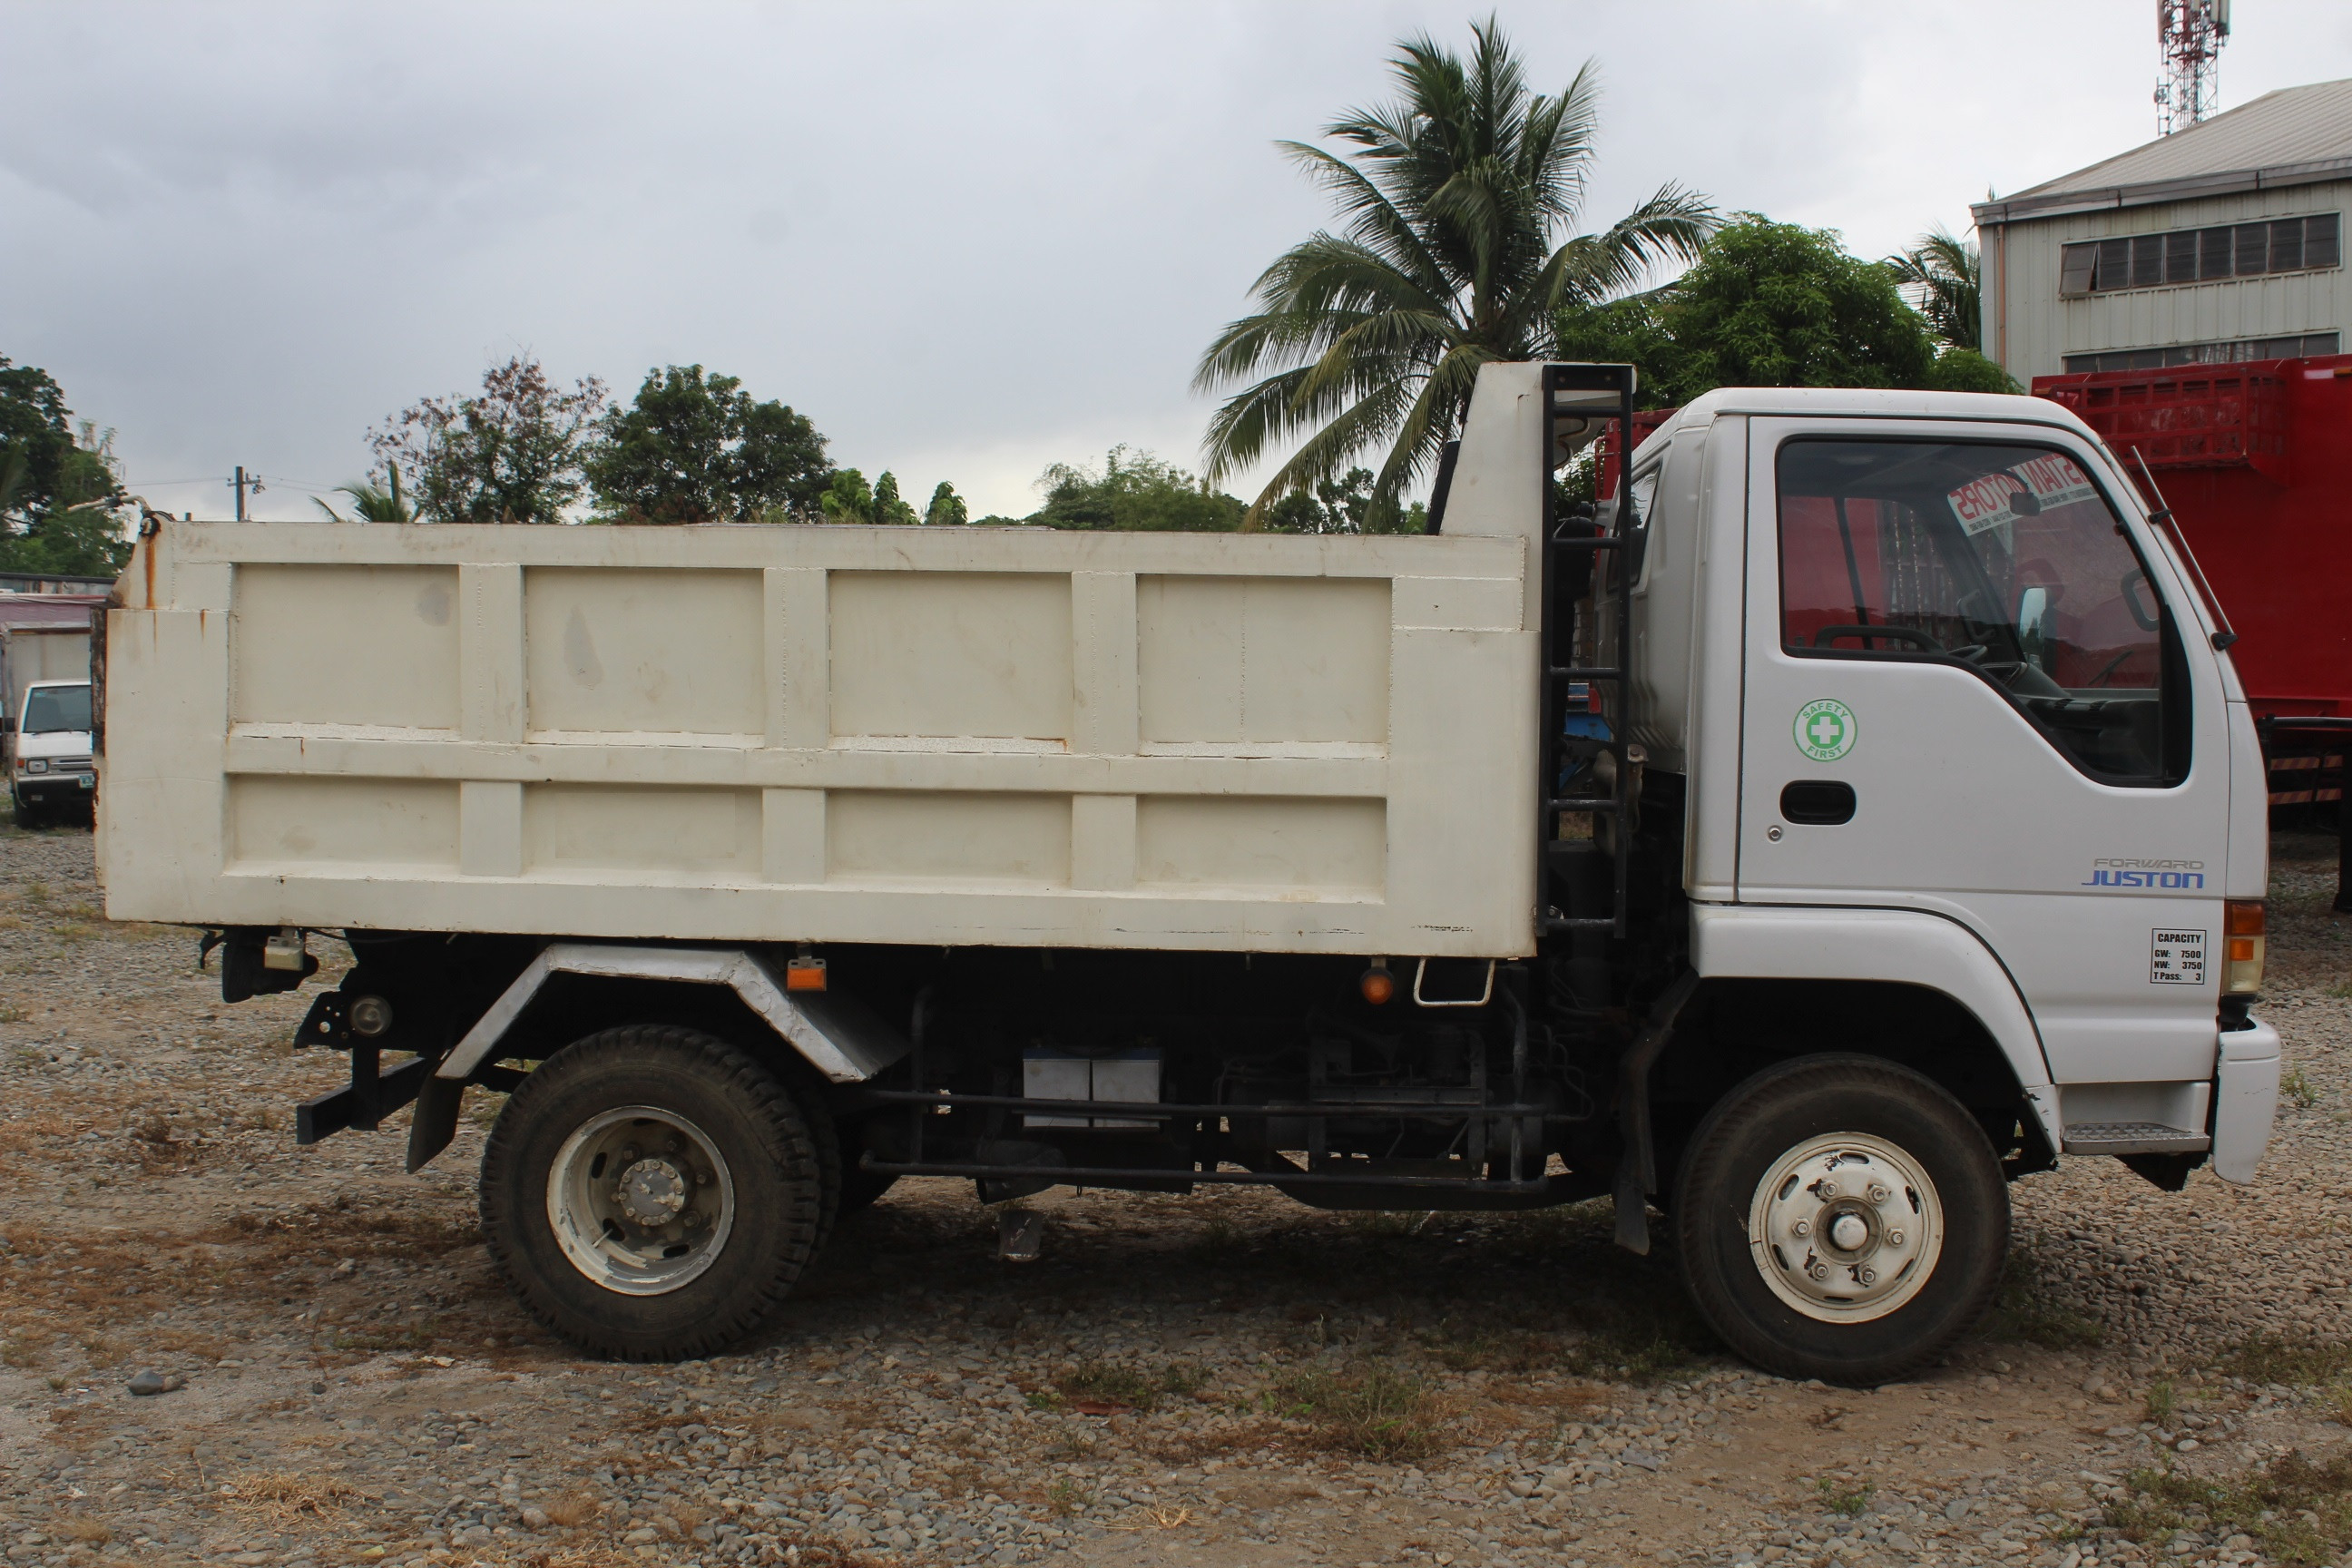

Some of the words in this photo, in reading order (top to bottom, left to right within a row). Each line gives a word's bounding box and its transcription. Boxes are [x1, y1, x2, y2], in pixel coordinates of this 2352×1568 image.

[1802, 702, 1848, 719] SAFETY
[1807, 745, 1842, 759] FIRST
[2093, 858, 2205, 870] FORWARD
[2081, 869, 2203, 889] JUSTON
[2157, 933, 2201, 944] CAPACITY
[2154, 949, 2171, 958] GW:
[2180, 950, 2201, 959] 7500
[2153, 960, 2171, 969] NW:
[2181, 962, 2202, 970] 3750
[2153, 972, 2159, 980] T
[2160, 972, 2182, 981] Pass:
[2195, 973, 2201, 982] 3
